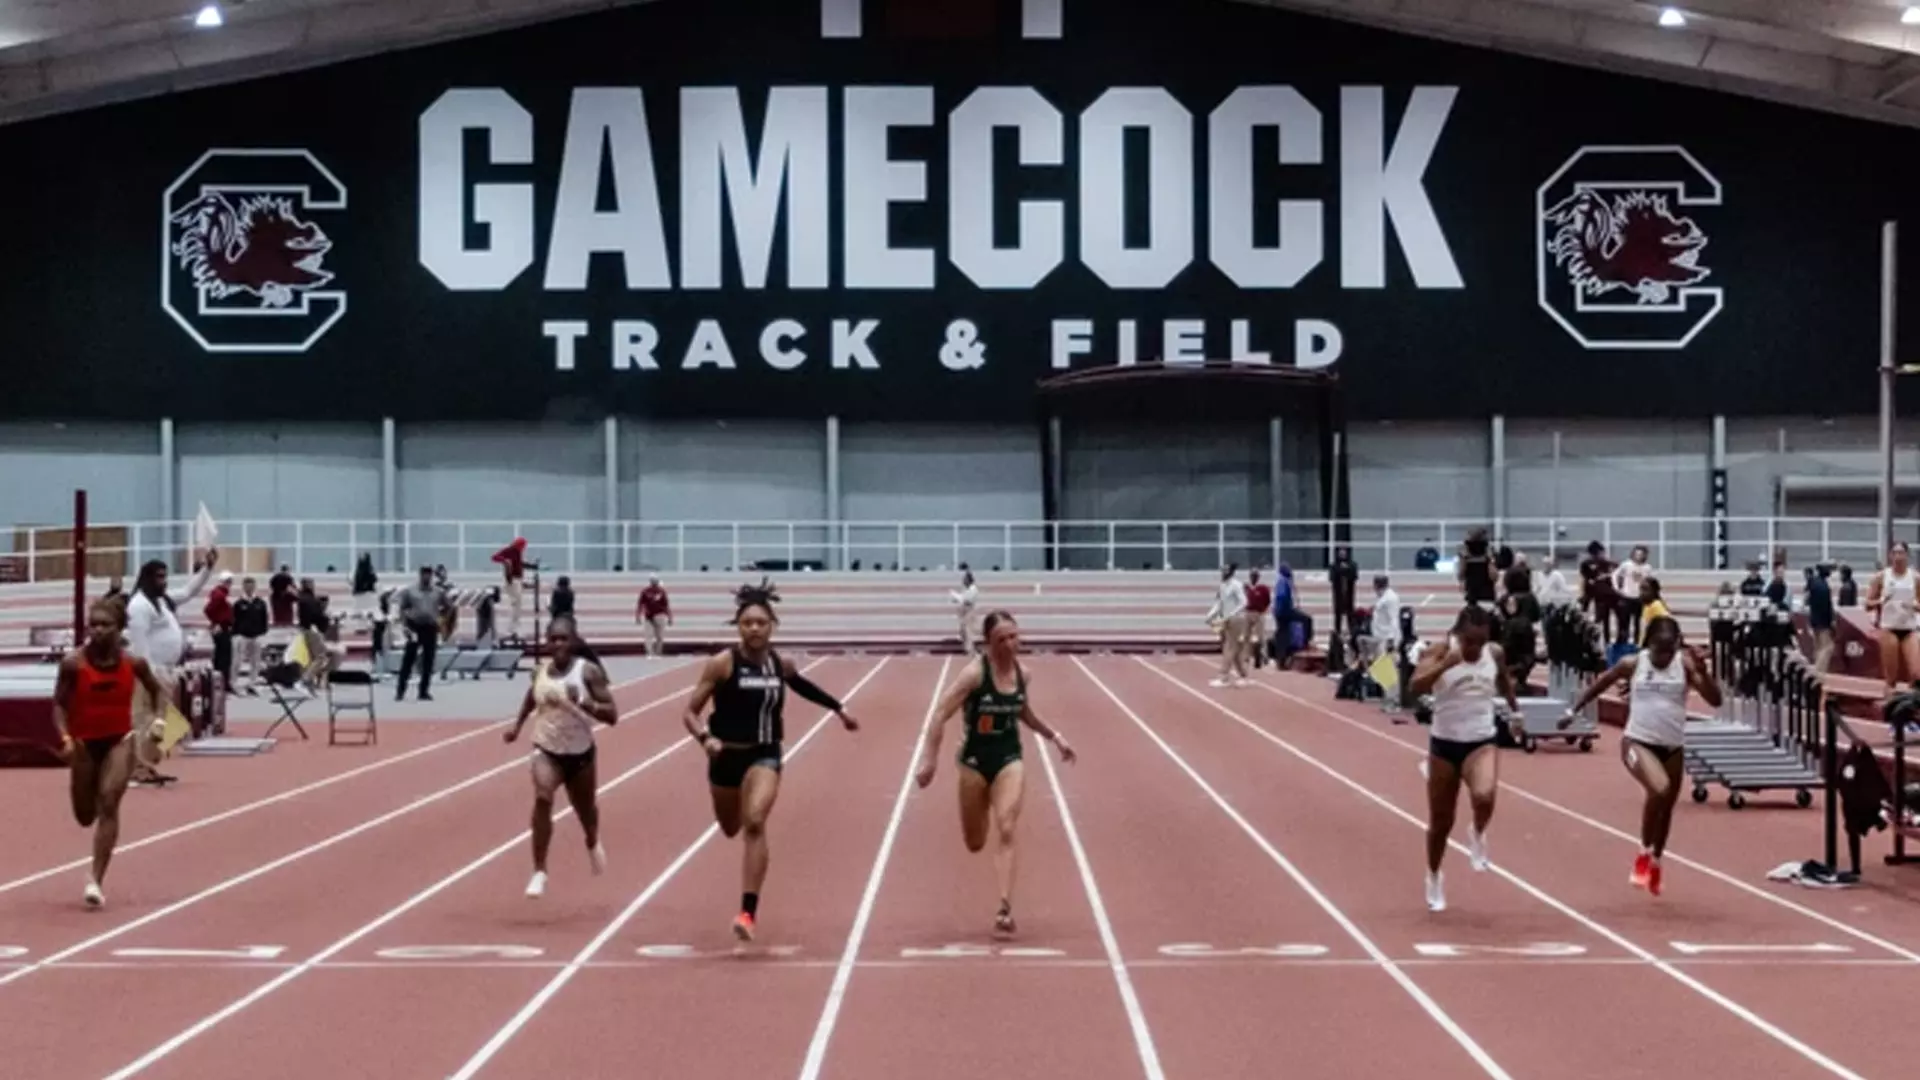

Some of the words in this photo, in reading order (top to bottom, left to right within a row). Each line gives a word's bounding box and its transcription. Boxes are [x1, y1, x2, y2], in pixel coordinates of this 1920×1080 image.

[419, 86, 1465, 290] GAMECOCK
[543, 319, 880, 369] TRACK
[939, 319, 985, 369] &
[1052, 319, 1342, 369] FIELD
